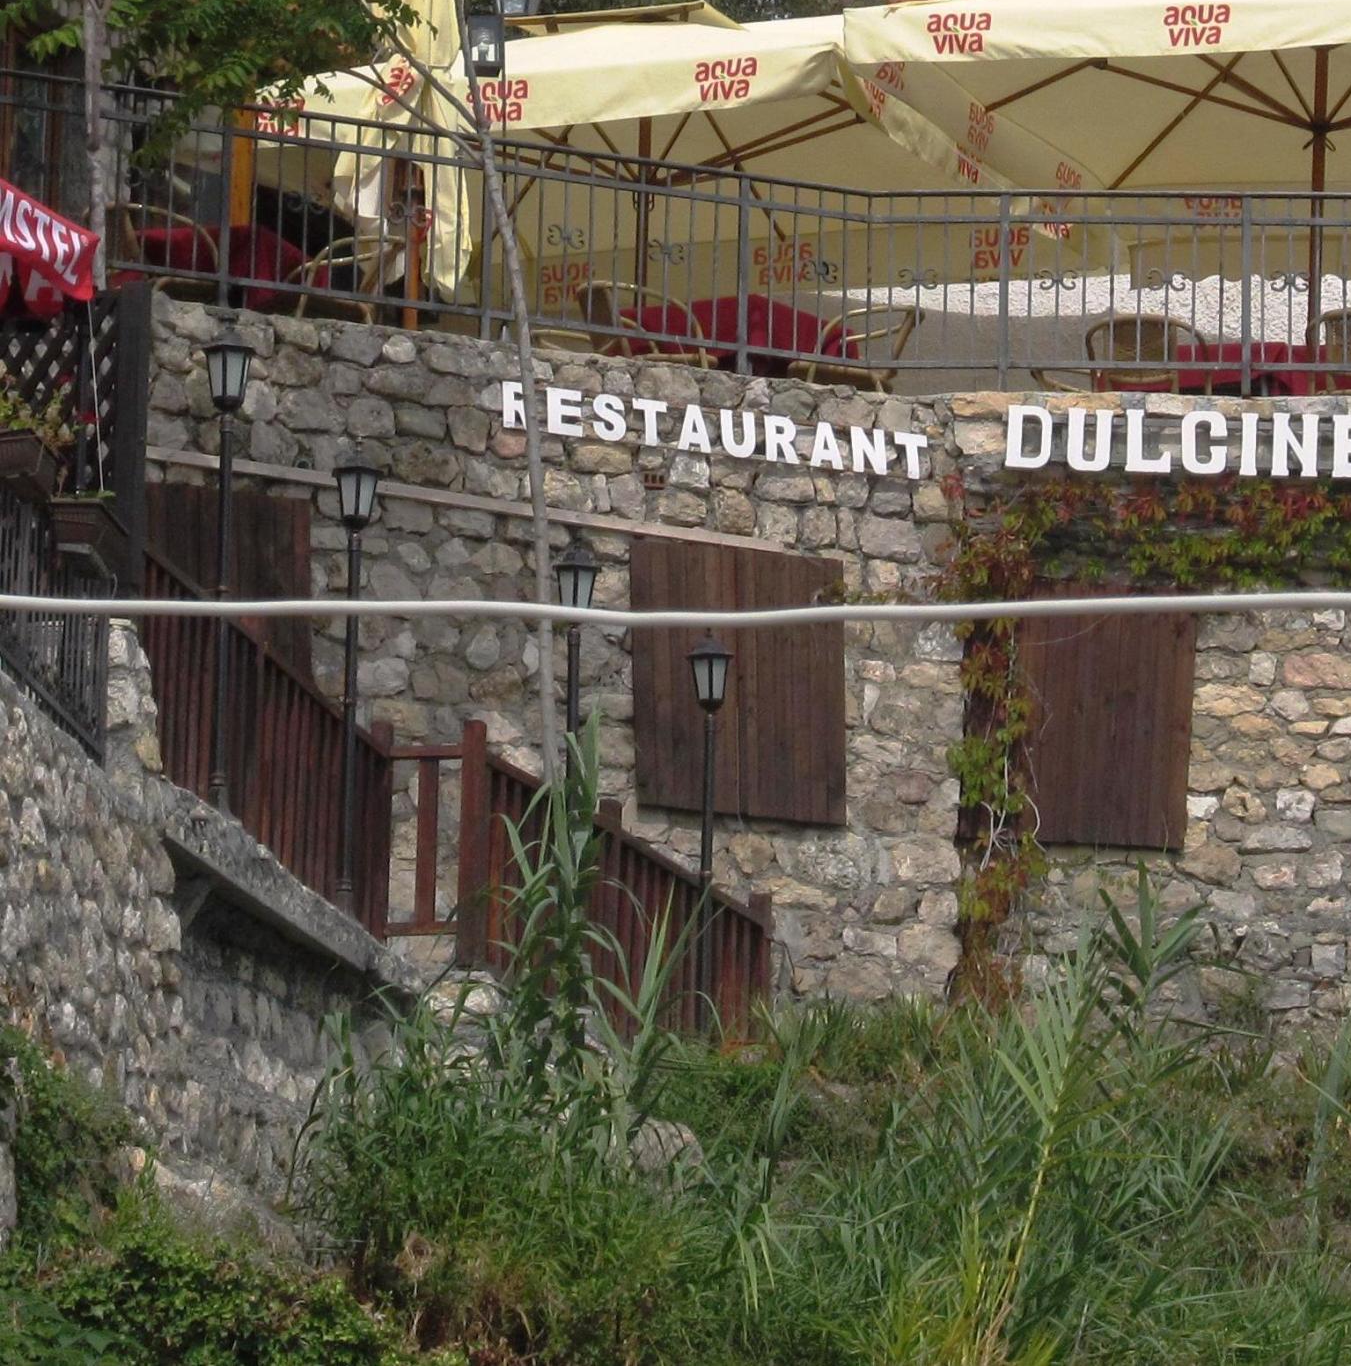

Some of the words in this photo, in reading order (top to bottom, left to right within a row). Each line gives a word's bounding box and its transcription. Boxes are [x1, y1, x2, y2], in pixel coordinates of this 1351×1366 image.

[927, 13, 991, 33] aqua
[1163, 4, 1230, 26] aqua
[933, 33, 983, 54] viva
[1169, 26, 1221, 46] viva
[695, 57, 757, 82] aqua
[700, 79, 749, 101] viva
[480, 102, 522, 122] iva
[0, 189, 81, 285] ASTEL
[502, 381, 928, 480] RESTAURANT
